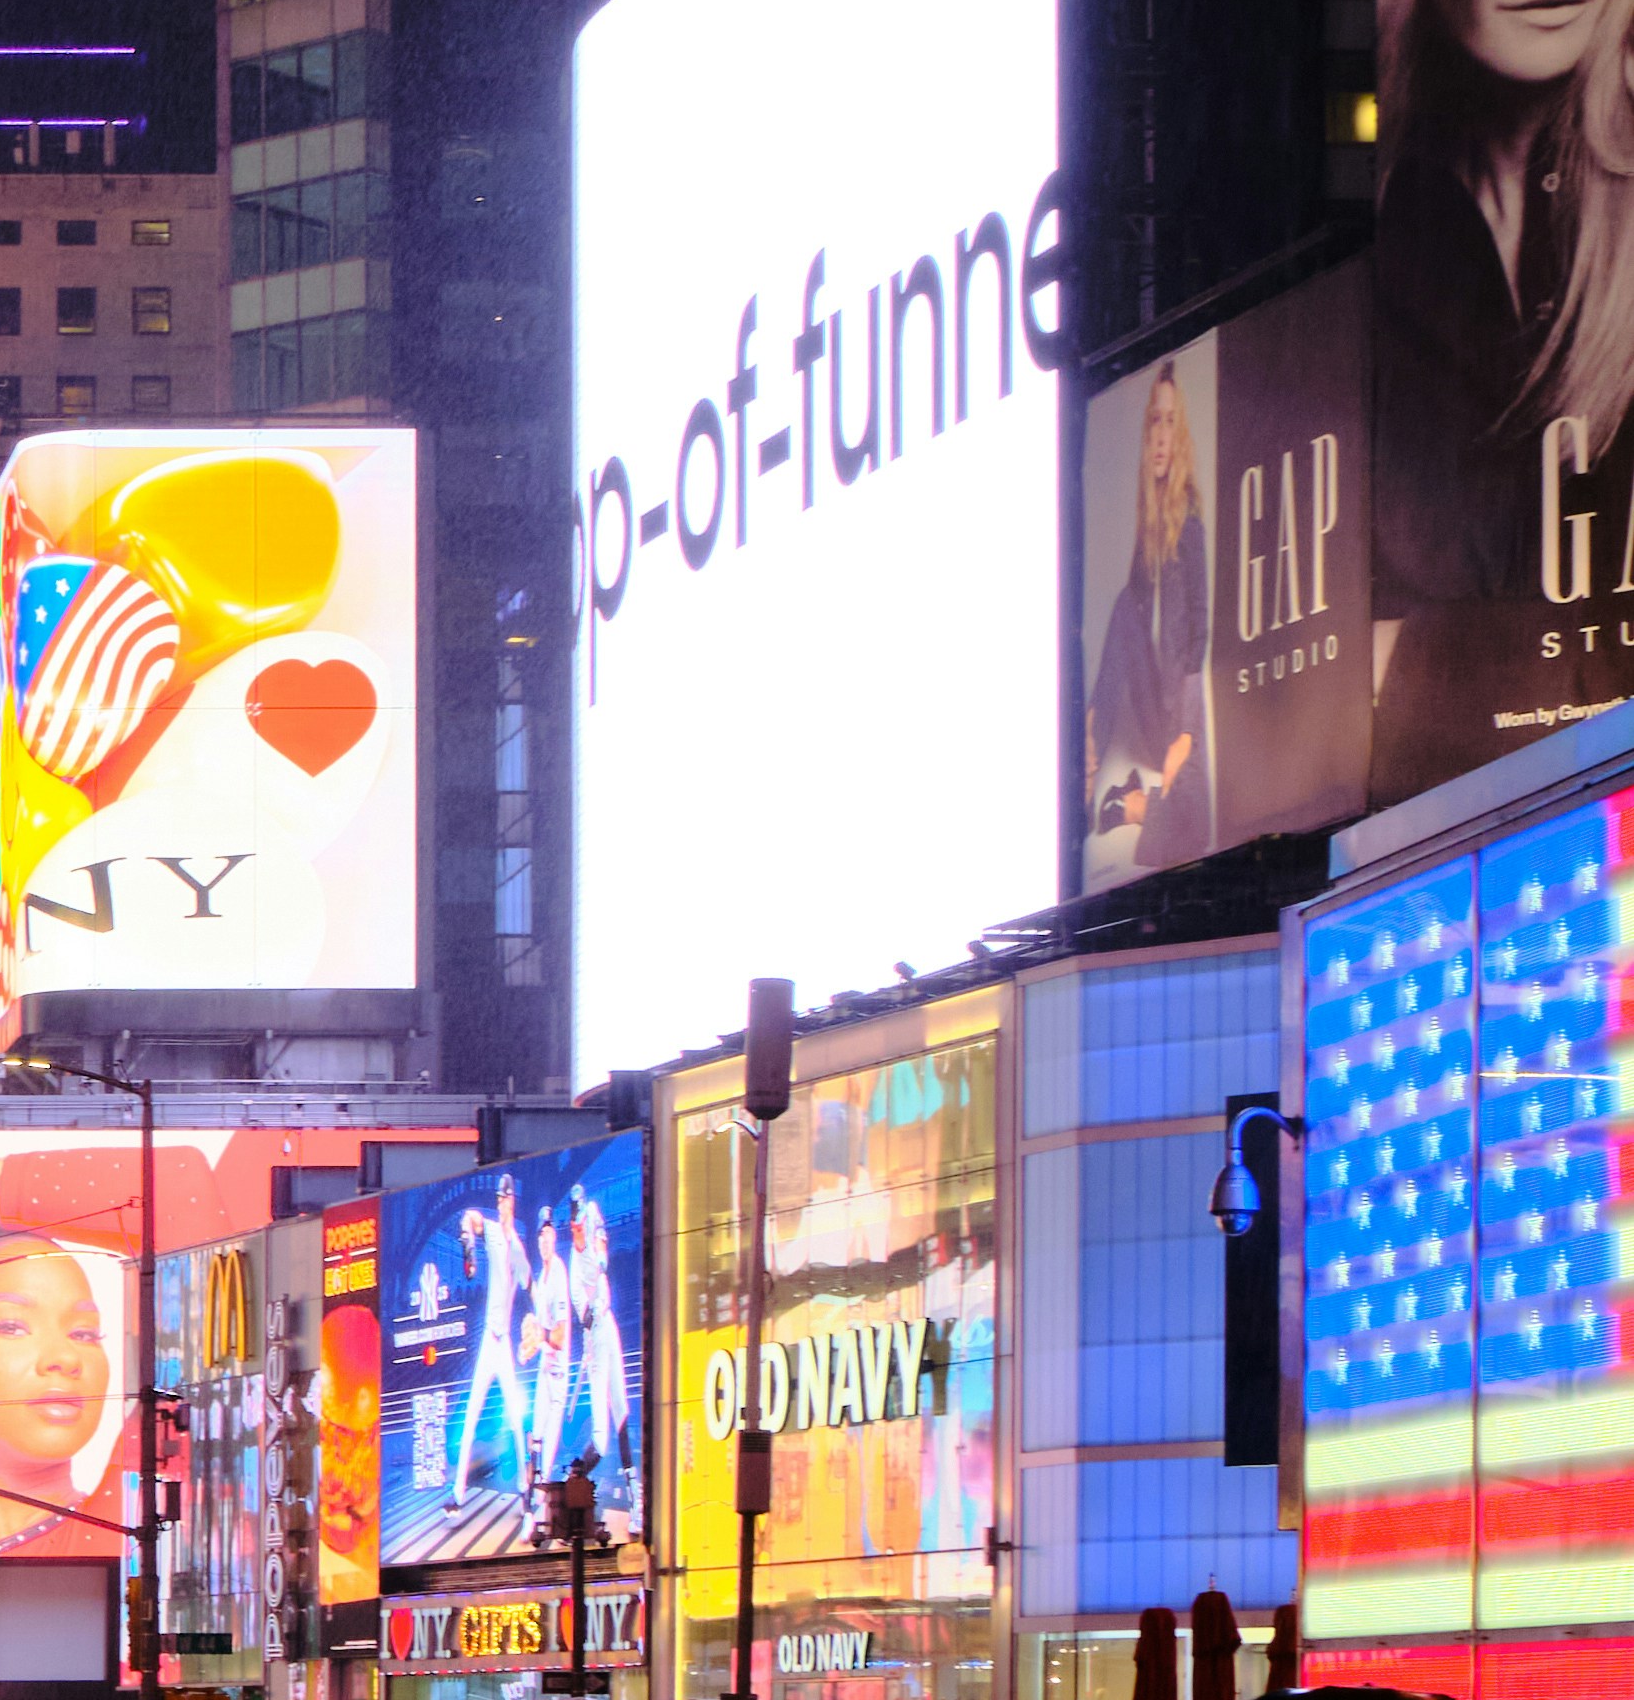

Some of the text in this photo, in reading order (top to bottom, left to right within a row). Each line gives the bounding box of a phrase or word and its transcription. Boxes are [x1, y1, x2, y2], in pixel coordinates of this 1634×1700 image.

[572, 168, 1061, 707] p-of-funne
[1239, 433, 1338, 642] GAP
[1238, 635, 1339, 693] STUDIO
[22, 853, 257, 962] NY
[704, 1318, 929, 1440] OLD NAVY
[460, 1602, 541, 1657] GIFTS
[778, 1631, 868, 1673] OLD NAVY
